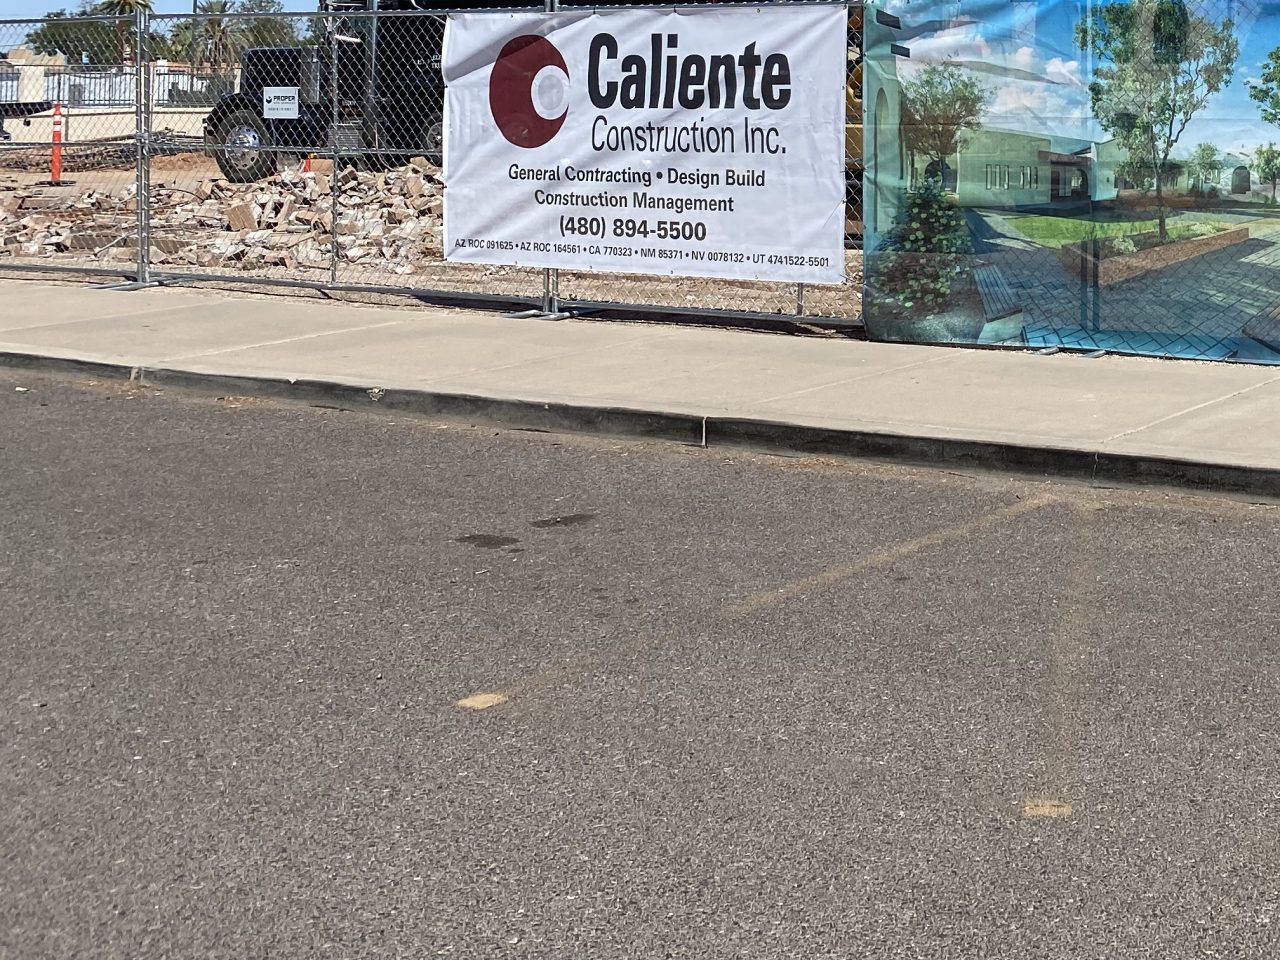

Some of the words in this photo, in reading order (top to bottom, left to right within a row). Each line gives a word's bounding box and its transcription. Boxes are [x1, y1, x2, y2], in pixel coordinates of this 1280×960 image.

[588, 33, 791, 110] Caliente
[592, 115, 735, 153] Construction
[744, 117, 786, 154] Inc.
[508, 163, 560, 182] General
[564, 166, 651, 186] Contracting
[667, 168, 720, 189] Design
[725, 169, 766, 186] Build
[534, 189, 628, 208] Construction
[633, 191, 734, 213] Management
[559, 215, 606, 238] (480)
[612, 218, 707, 240] 894-5500
[455, 239, 467, 248] AZ
[468, 239, 485, 249] ROC
[486, 240, 514, 250] 091625
[520, 242, 531, 251] AZ
[533, 243, 550, 252] ROC
[553, 243, 581, 254] 164561
[588, 245, 600, 255] CA
[603, 246, 633, 257] 770323
[640, 248, 656, 258] NM
[658, 249, 683, 259] 85371
[691, 250, 705, 260] NV
[707, 251, 744, 262] 0078132
[752, 253, 766, 264] UT
[767, 255, 829, 267] 4741522-5501
